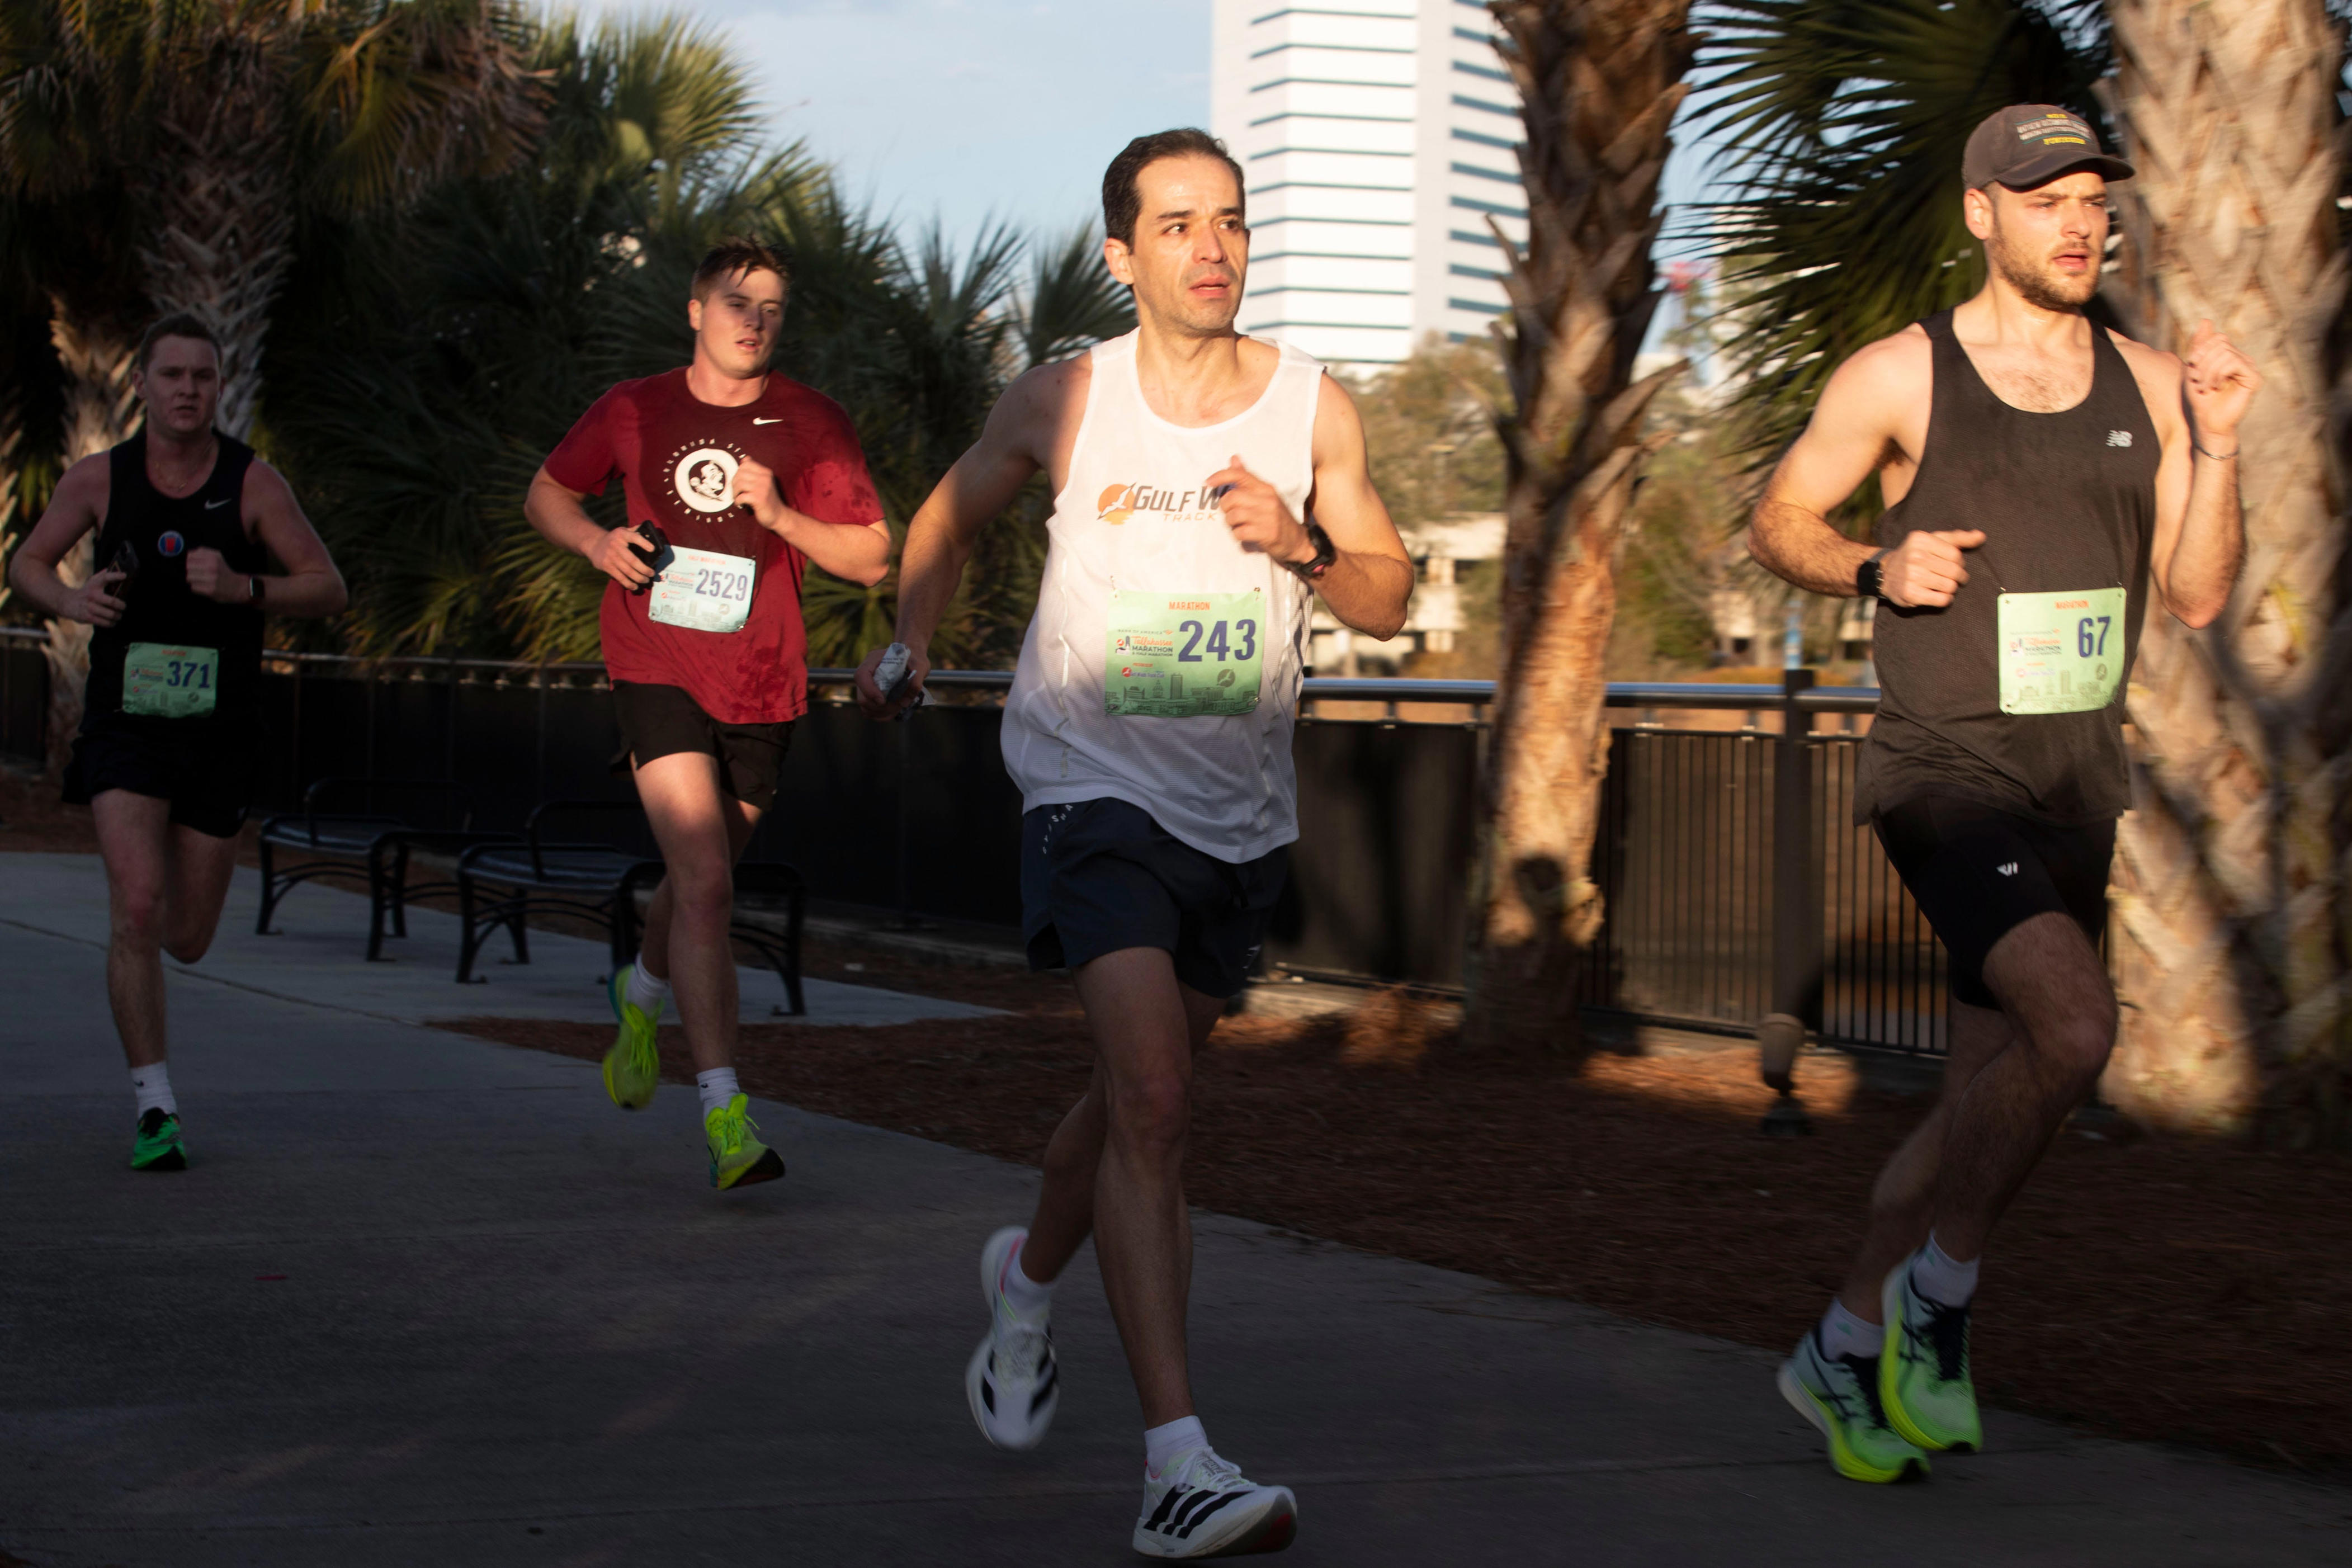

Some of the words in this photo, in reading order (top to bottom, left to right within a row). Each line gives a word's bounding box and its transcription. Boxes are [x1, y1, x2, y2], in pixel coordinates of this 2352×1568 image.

[1133, 485, 1196, 512] GULF
[1163, 512, 1217, 522] TRACK
[696, 569, 748, 601] 2529
[1169, 601, 1211, 611] MARATHON
[1178, 619, 1256, 662] 243
[2078, 616, 2110, 658] 67
[167, 661, 210, 688] 371
